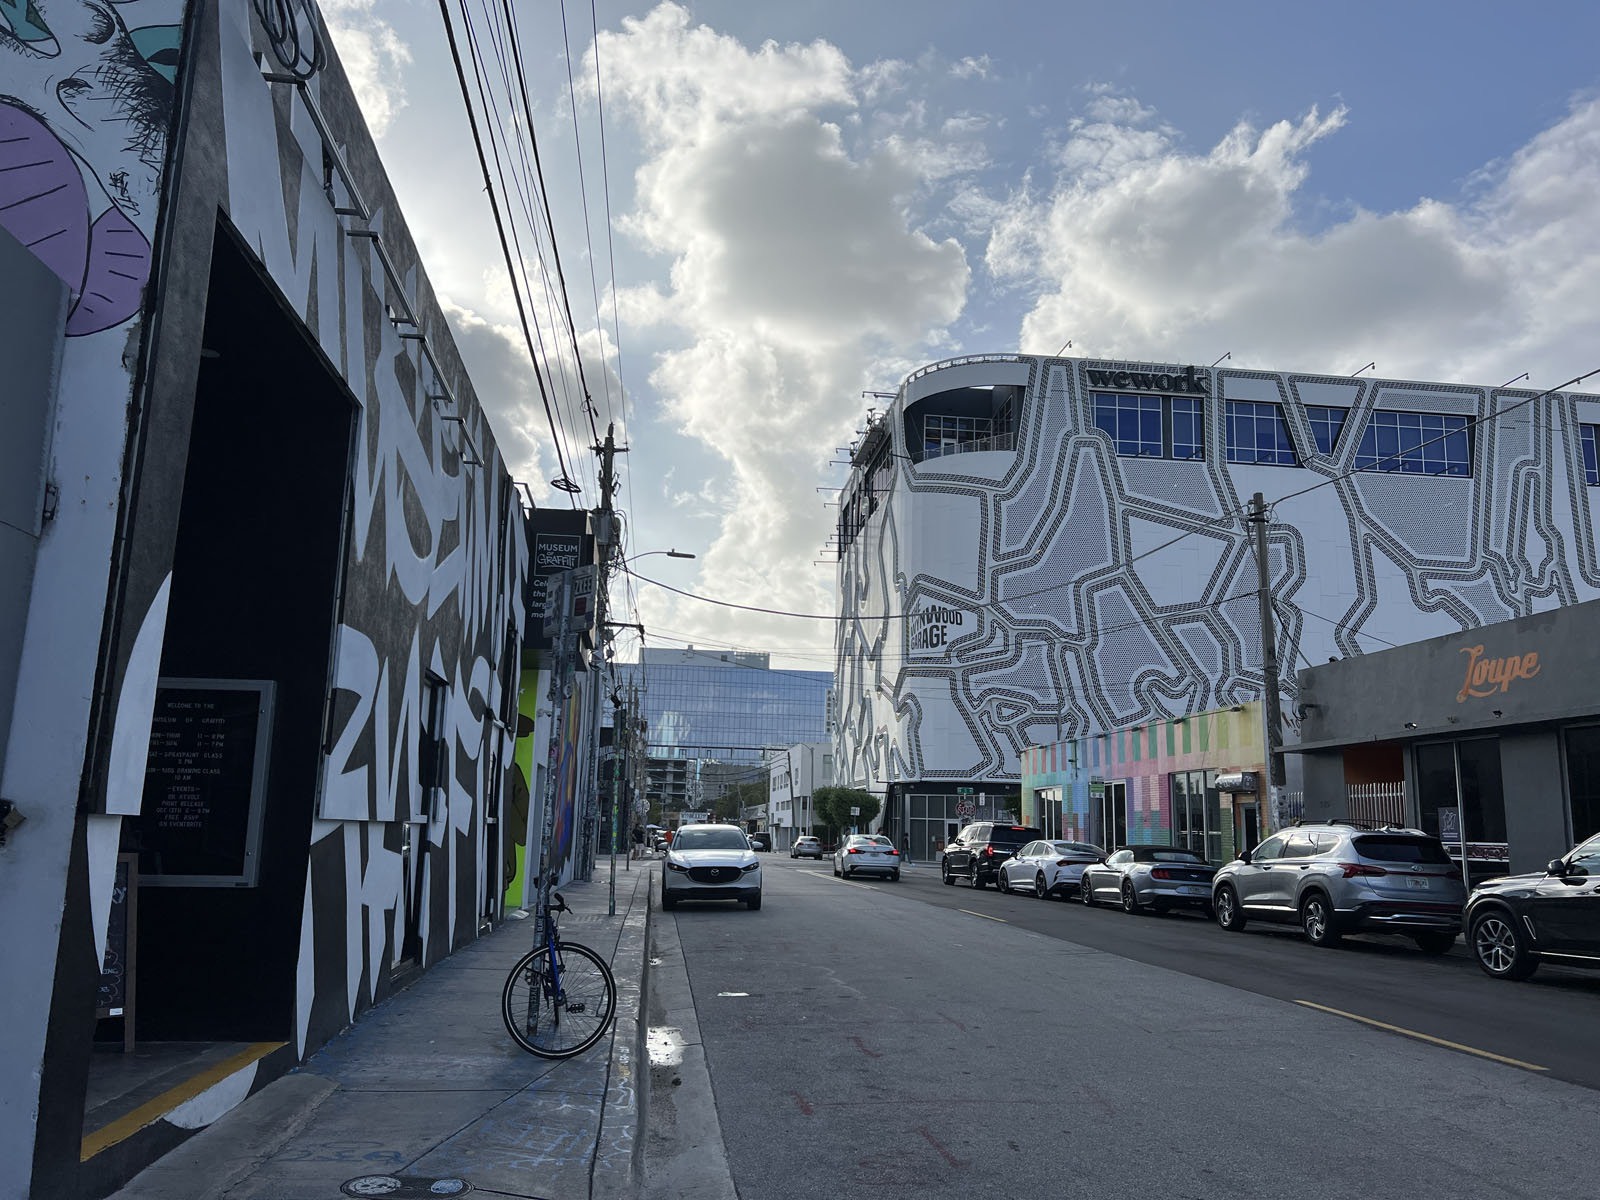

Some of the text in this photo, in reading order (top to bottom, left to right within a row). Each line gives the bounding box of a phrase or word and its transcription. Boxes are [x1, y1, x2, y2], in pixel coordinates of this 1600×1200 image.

[1087, 366, 1209, 393] wework
[538, 543, 578, 553] MUSEUM
[1456, 644, 1541, 704] Loupe
